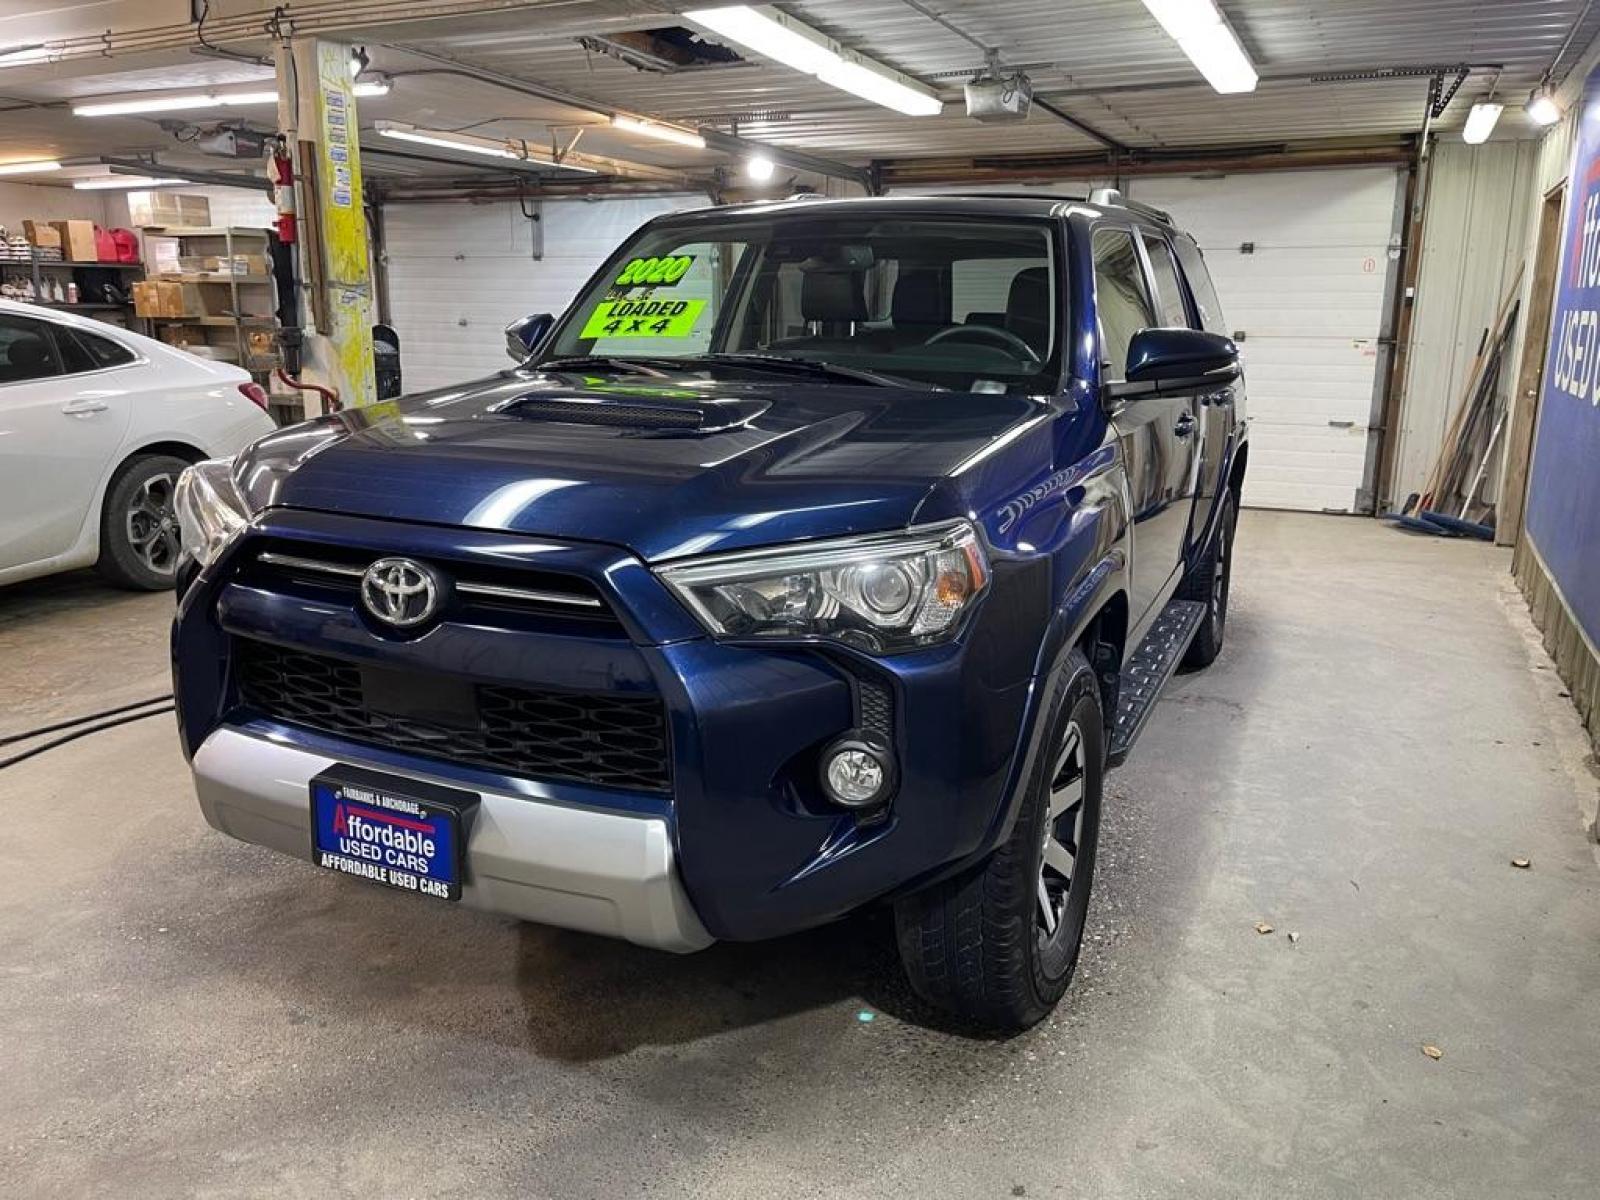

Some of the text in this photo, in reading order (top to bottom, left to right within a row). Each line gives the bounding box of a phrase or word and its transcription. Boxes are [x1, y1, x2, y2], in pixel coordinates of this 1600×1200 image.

[615, 256, 693, 286] 2020
[607, 301, 689, 317] LOADED
[1554, 310, 1598, 399] USED
[333, 800, 436, 858] Affordable
[321, 852, 449, 899] AFFORDABLE USED CARS
[340, 837, 430, 874] USED CARS
